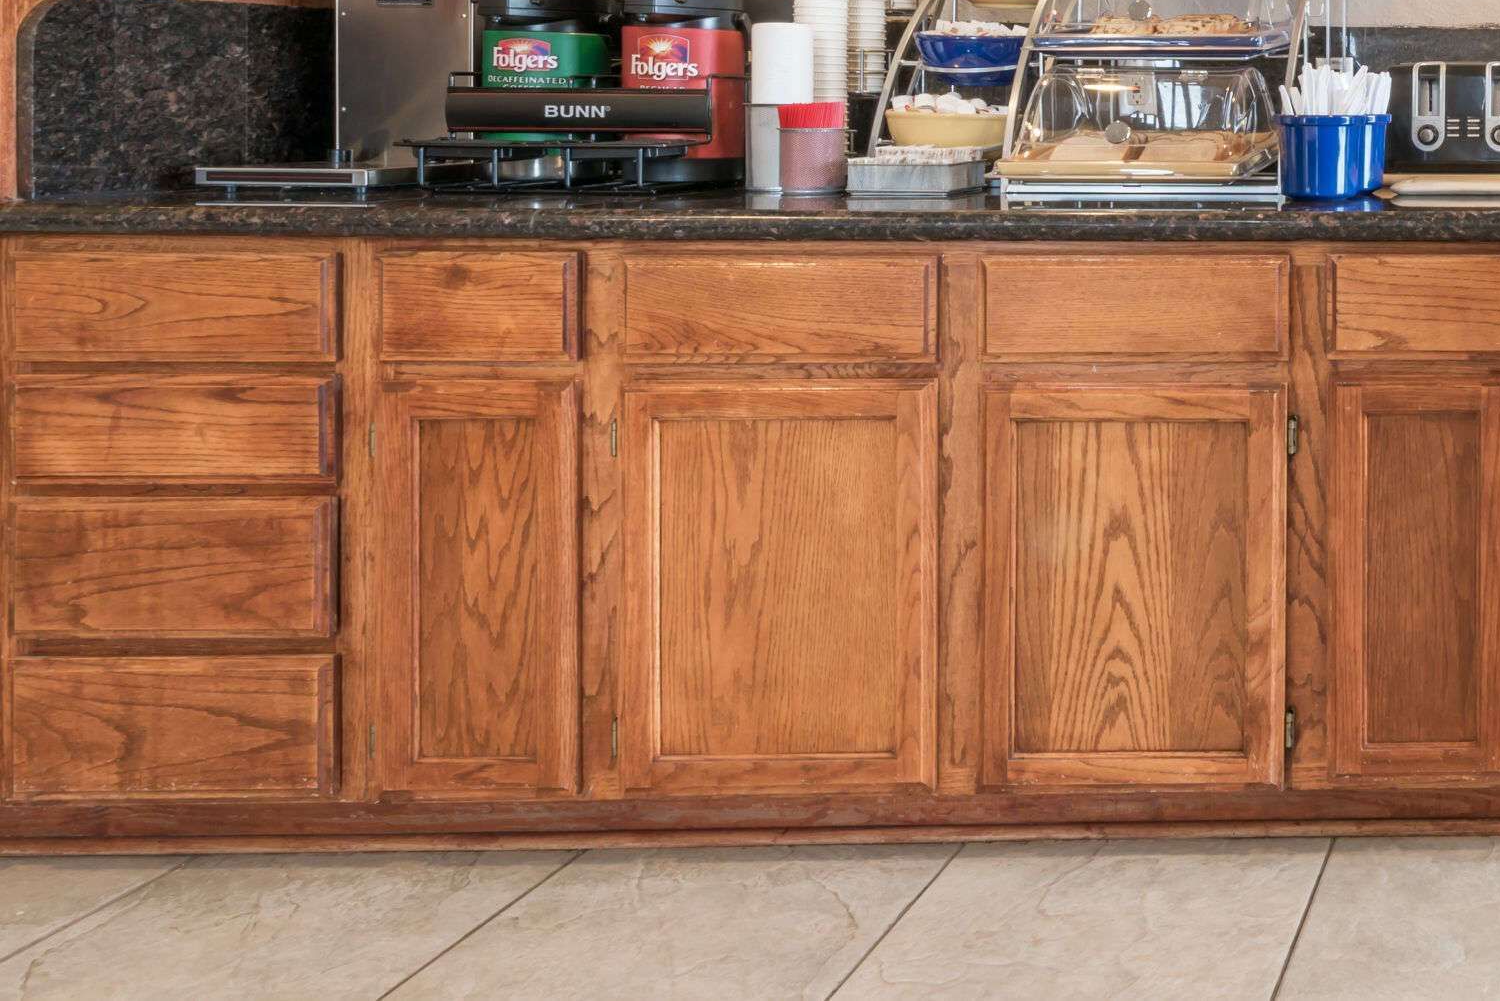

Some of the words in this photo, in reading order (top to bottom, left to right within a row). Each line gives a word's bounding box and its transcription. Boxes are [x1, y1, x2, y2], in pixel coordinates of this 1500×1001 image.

[492, 46, 559, 72] Folgers
[631, 54, 699, 81] Folgers
[487, 75, 567, 85] DECAFFEINATED
[544, 105, 606, 118] BUNN
